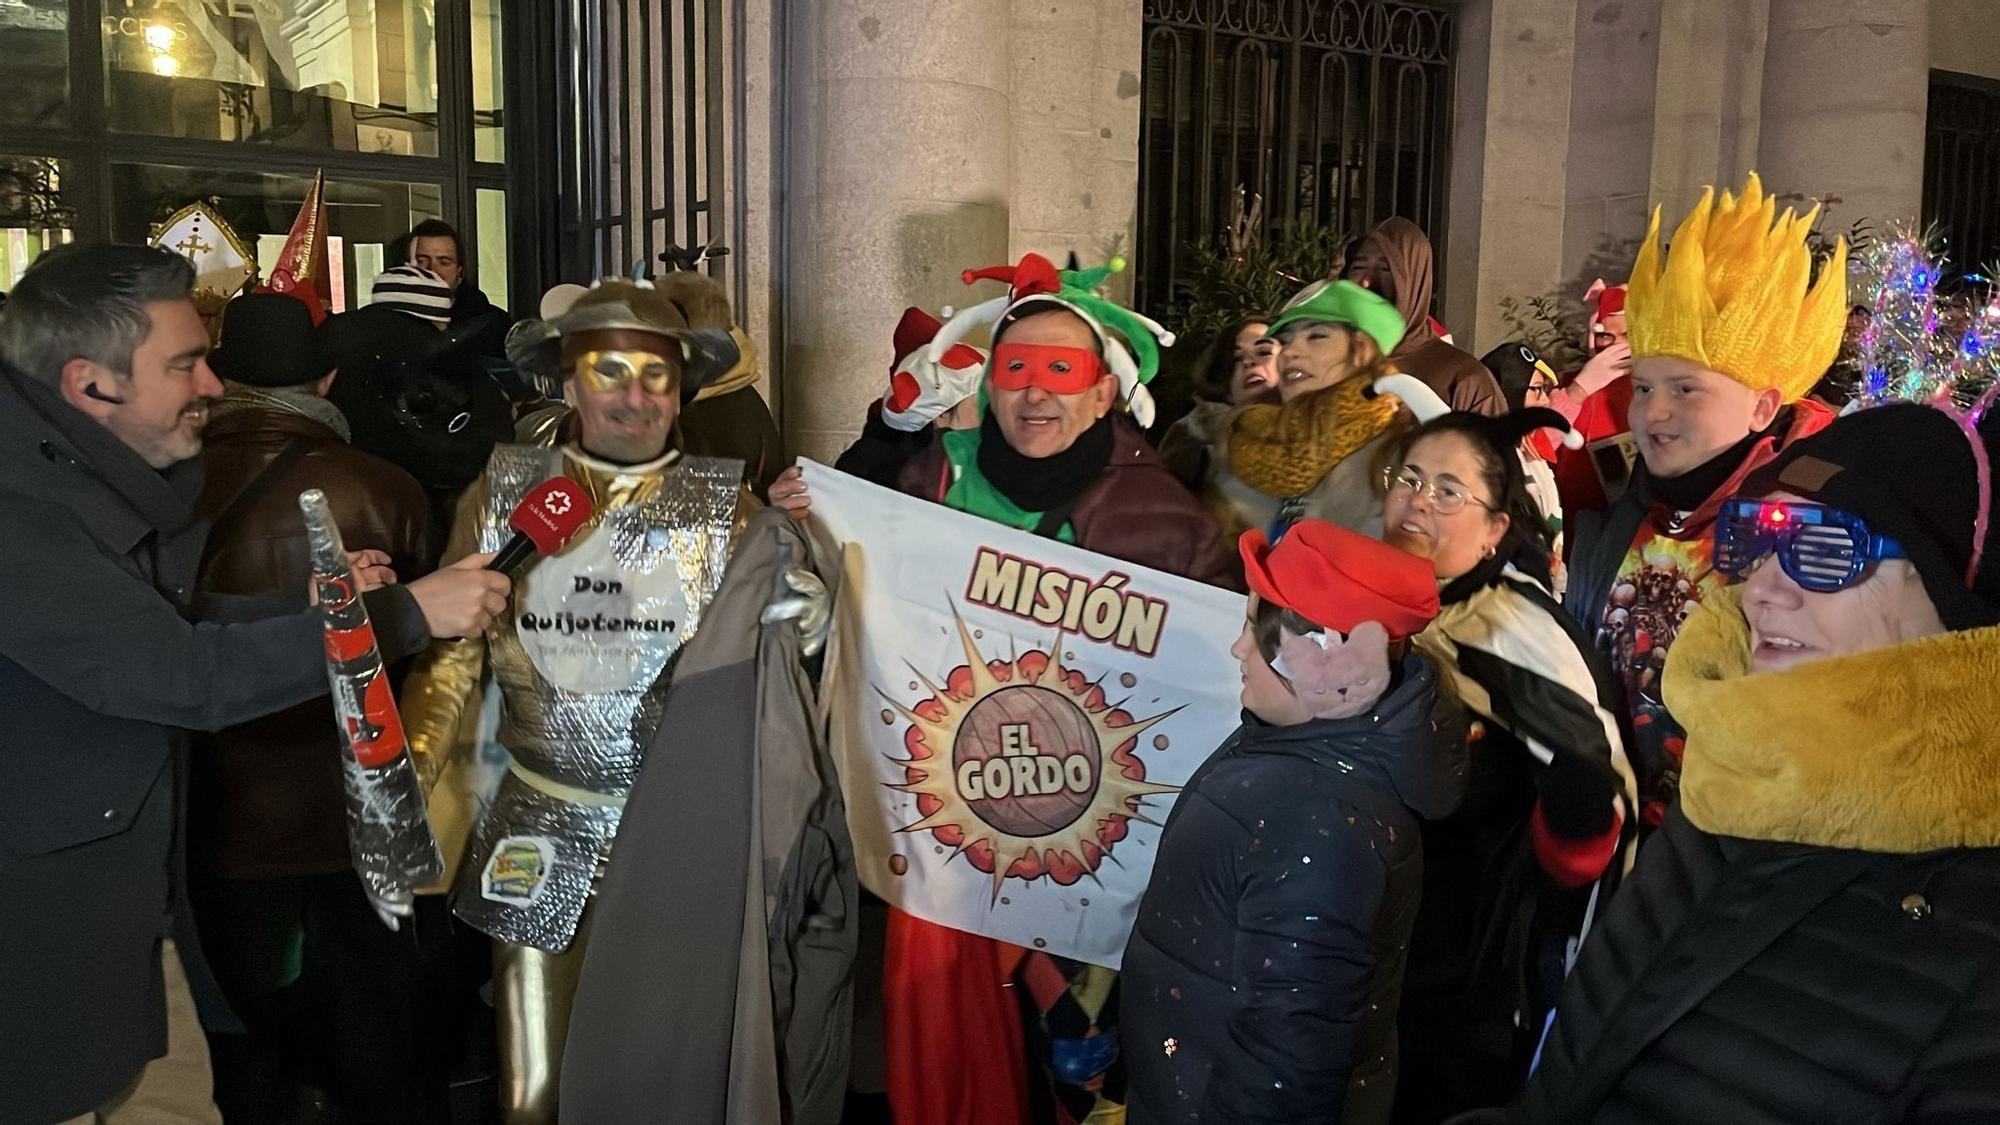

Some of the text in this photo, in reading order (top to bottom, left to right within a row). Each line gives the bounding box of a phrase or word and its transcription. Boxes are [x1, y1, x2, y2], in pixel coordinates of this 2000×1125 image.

[574, 575, 623, 594] Don
[965, 546, 1169, 659] MISIÓN
[520, 612, 676, 635] Quijoteman
[999, 723, 1040, 757] EL
[956, 753, 1092, 800] GORDO
